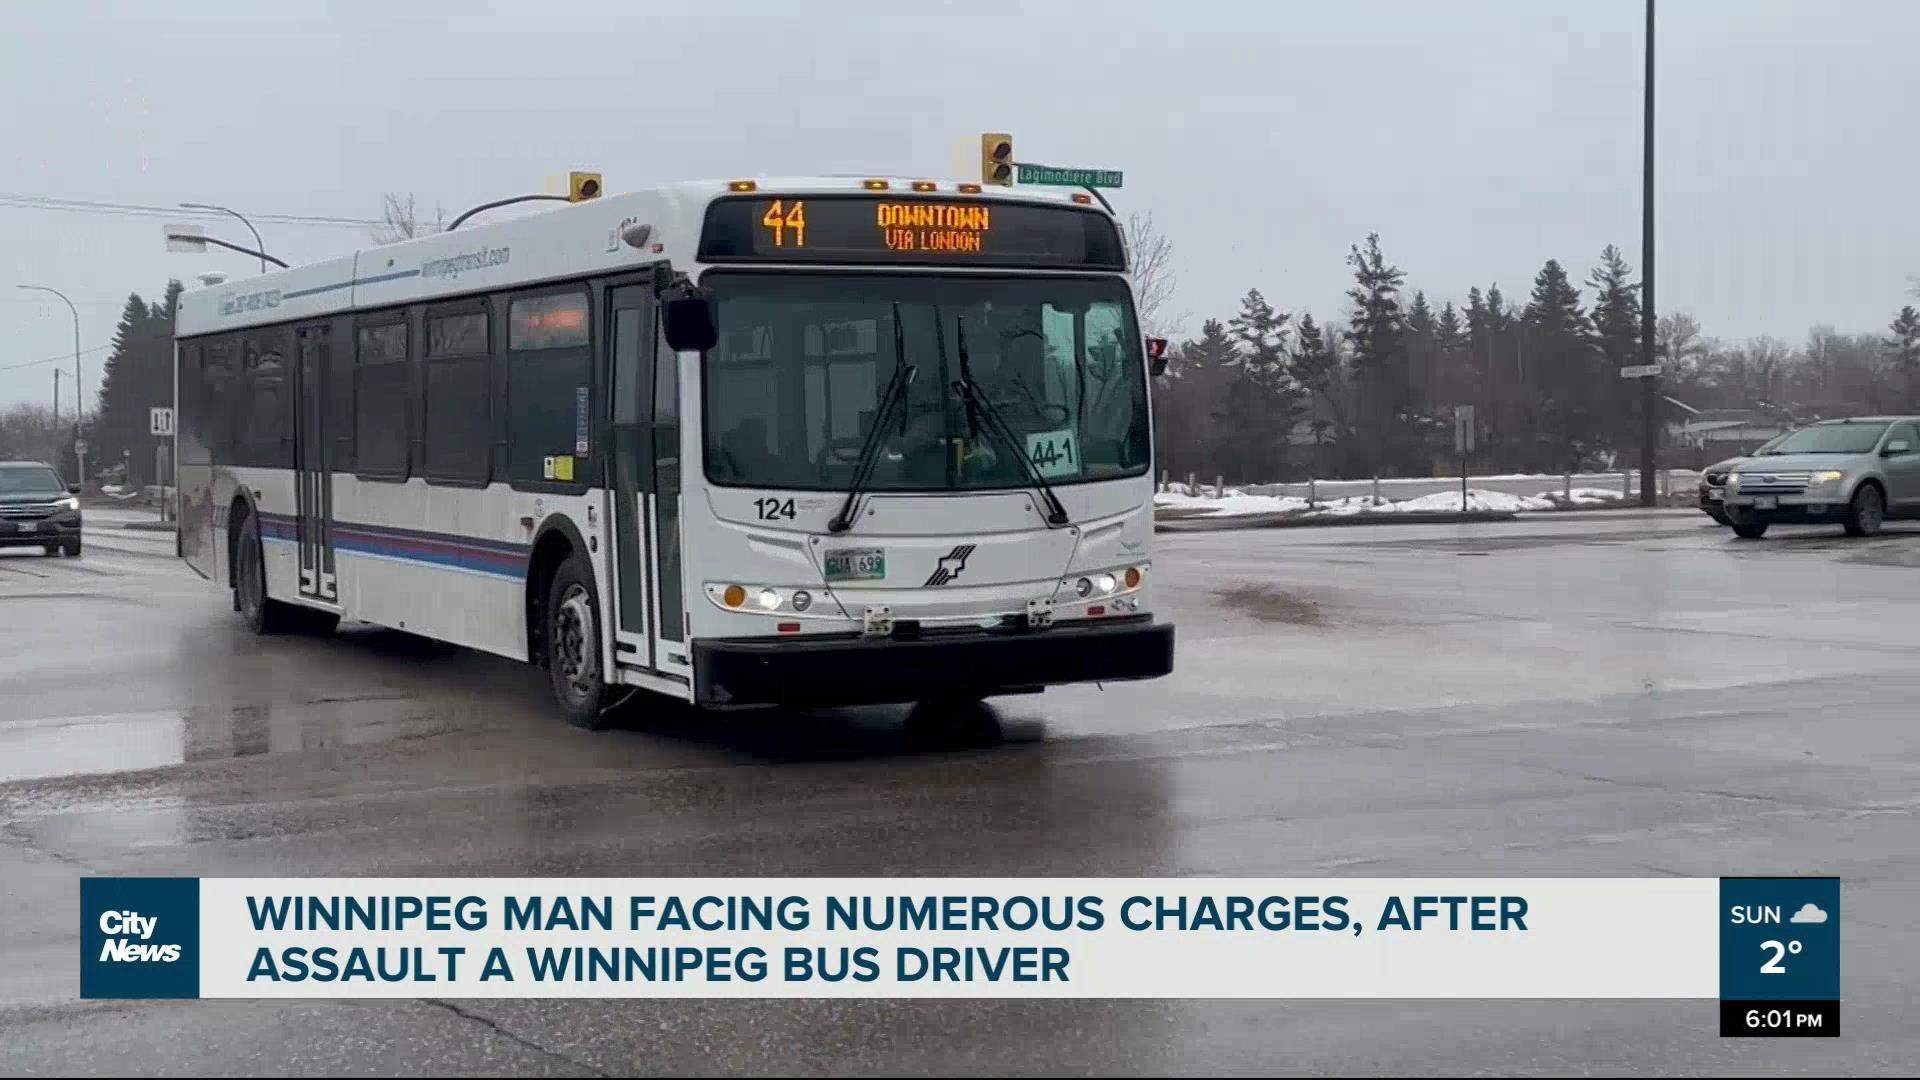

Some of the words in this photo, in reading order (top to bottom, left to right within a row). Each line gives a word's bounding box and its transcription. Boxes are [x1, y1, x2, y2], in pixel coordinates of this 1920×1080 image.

[1096, 171, 1121, 184] Blvd
[763, 200, 805, 247] 44
[877, 203, 989, 230] DOWNTOWN
[886, 229, 914, 249] VIA
[920, 232, 980, 251] LONDON
[1033, 438, 1073, 468] 44-1
[753, 498, 797, 519] 124
